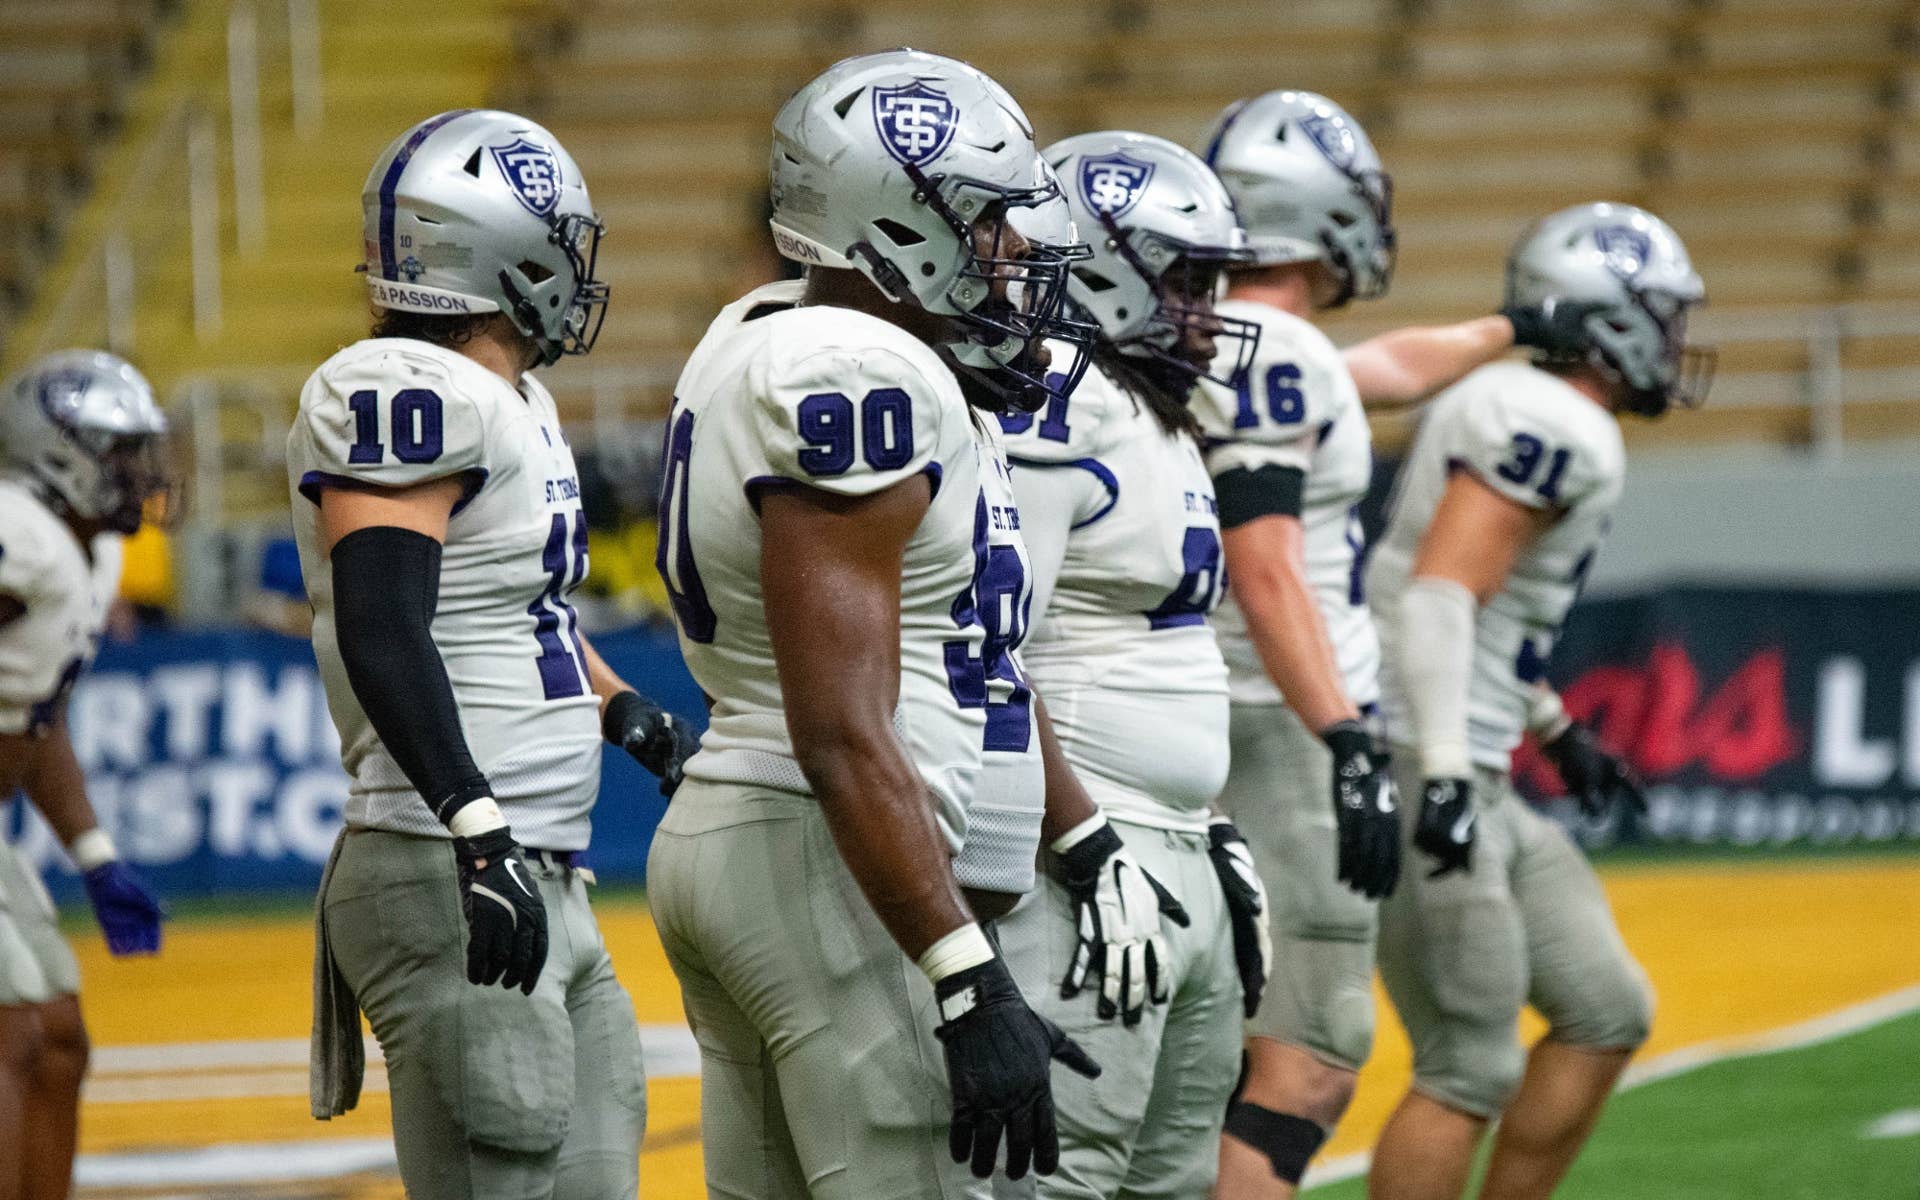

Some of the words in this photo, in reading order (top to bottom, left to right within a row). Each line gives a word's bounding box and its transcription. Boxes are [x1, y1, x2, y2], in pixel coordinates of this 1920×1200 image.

[400, 234, 412, 249] 10
[389, 287, 471, 313] PASSION
[348, 388, 444, 465] 10
[1232, 362, 1306, 430] 16
[797, 387, 914, 478] 90
[1497, 431, 1571, 498] 31
